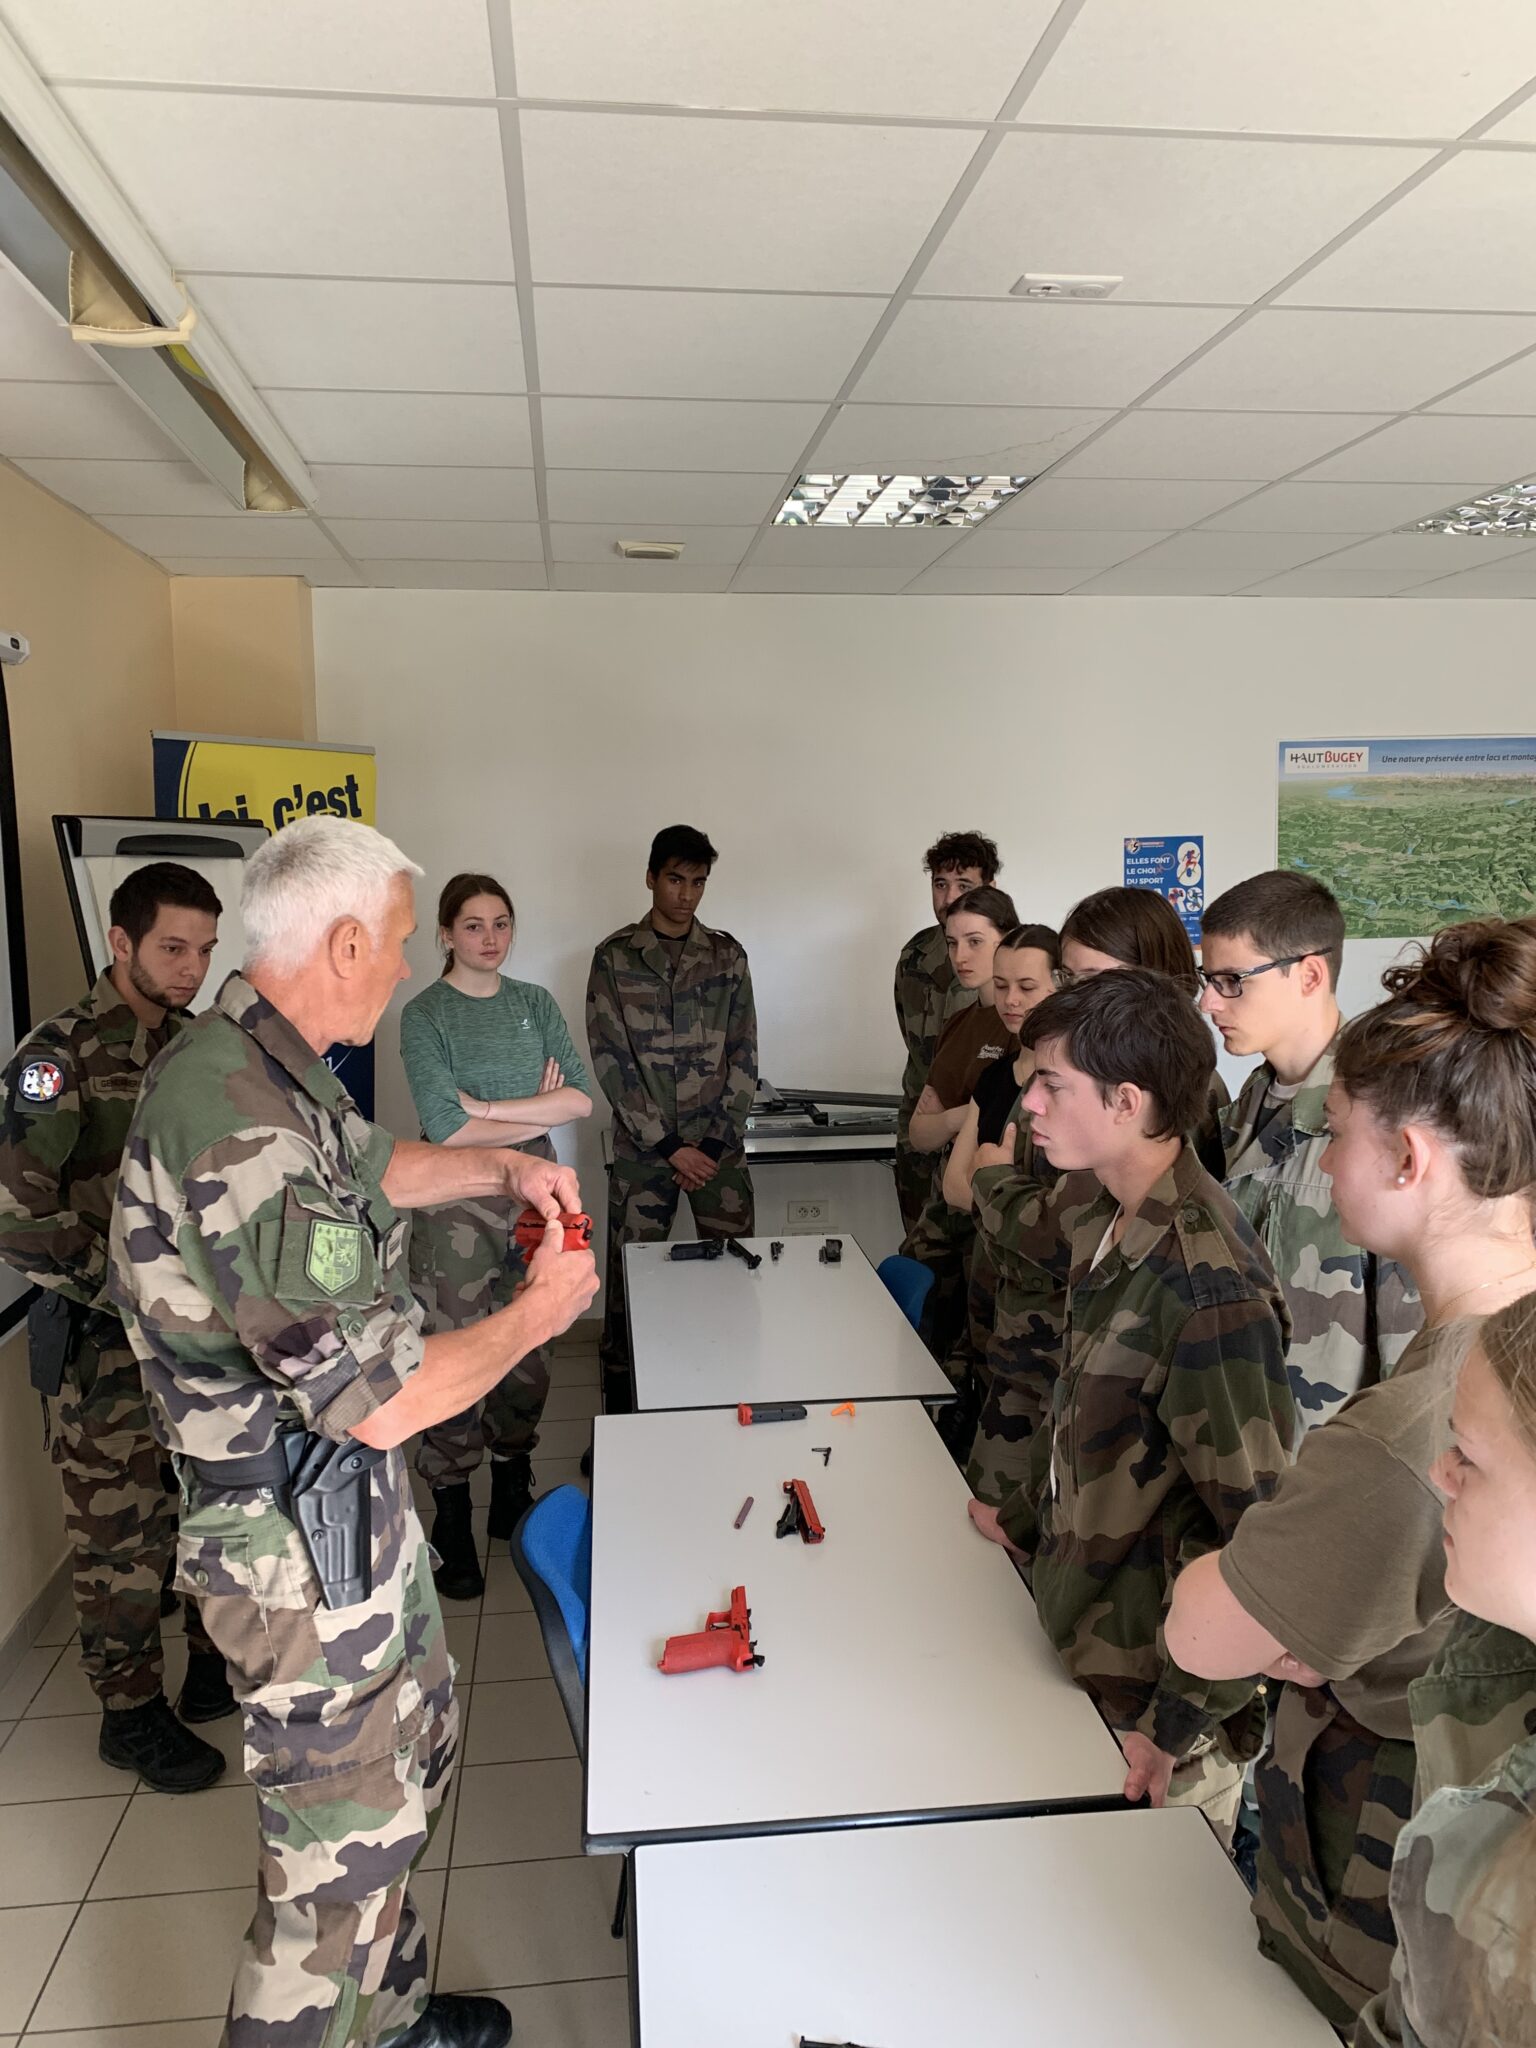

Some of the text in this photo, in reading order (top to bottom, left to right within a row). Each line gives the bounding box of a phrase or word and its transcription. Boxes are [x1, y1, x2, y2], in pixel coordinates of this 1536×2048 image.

[1382, 755, 1397, 763] Une
[1486, 753, 1500, 761] lacs
[1150, 856, 1170, 864] FONT
[1176, 841, 1202, 887] 8
